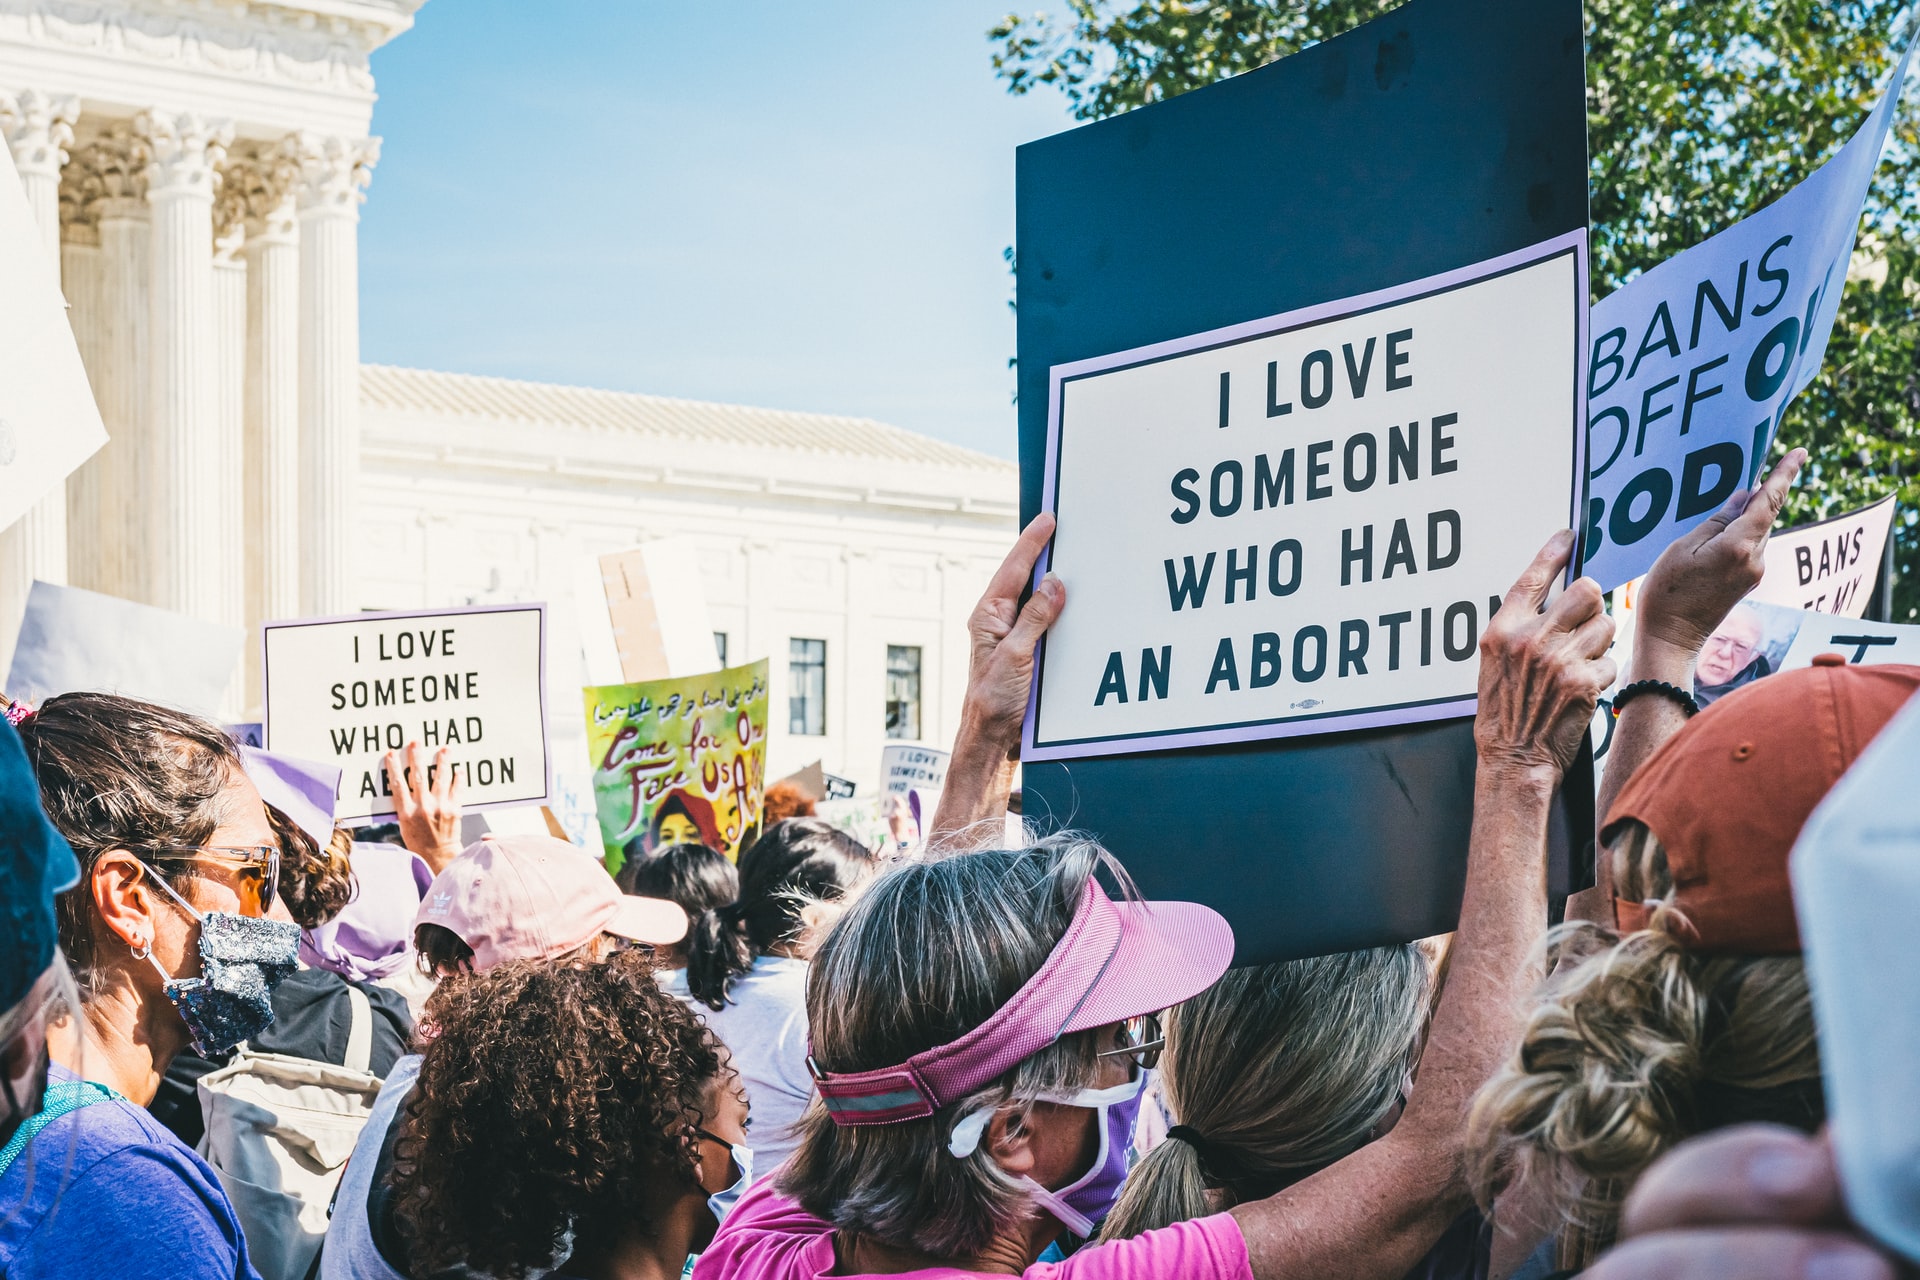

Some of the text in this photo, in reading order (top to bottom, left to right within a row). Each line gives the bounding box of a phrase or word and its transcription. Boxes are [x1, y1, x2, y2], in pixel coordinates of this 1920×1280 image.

[1589, 234, 1794, 400] BANS
[1218, 327, 1413, 429] I LOVE
[1590, 353, 1729, 480] OFF
[1170, 411, 1458, 525] SOMEONE
[1163, 509, 1461, 612] WHO HAD
[1795, 526, 1864, 586] BANS
[330, 672, 479, 711] SOMEONE
[354, 628, 455, 663] I LOVE
[1093, 594, 1502, 707] AN ABORTIO
[330, 716, 483, 755] WHO HAD
[603, 724, 668, 772] Come
[683, 715, 722, 763] for
